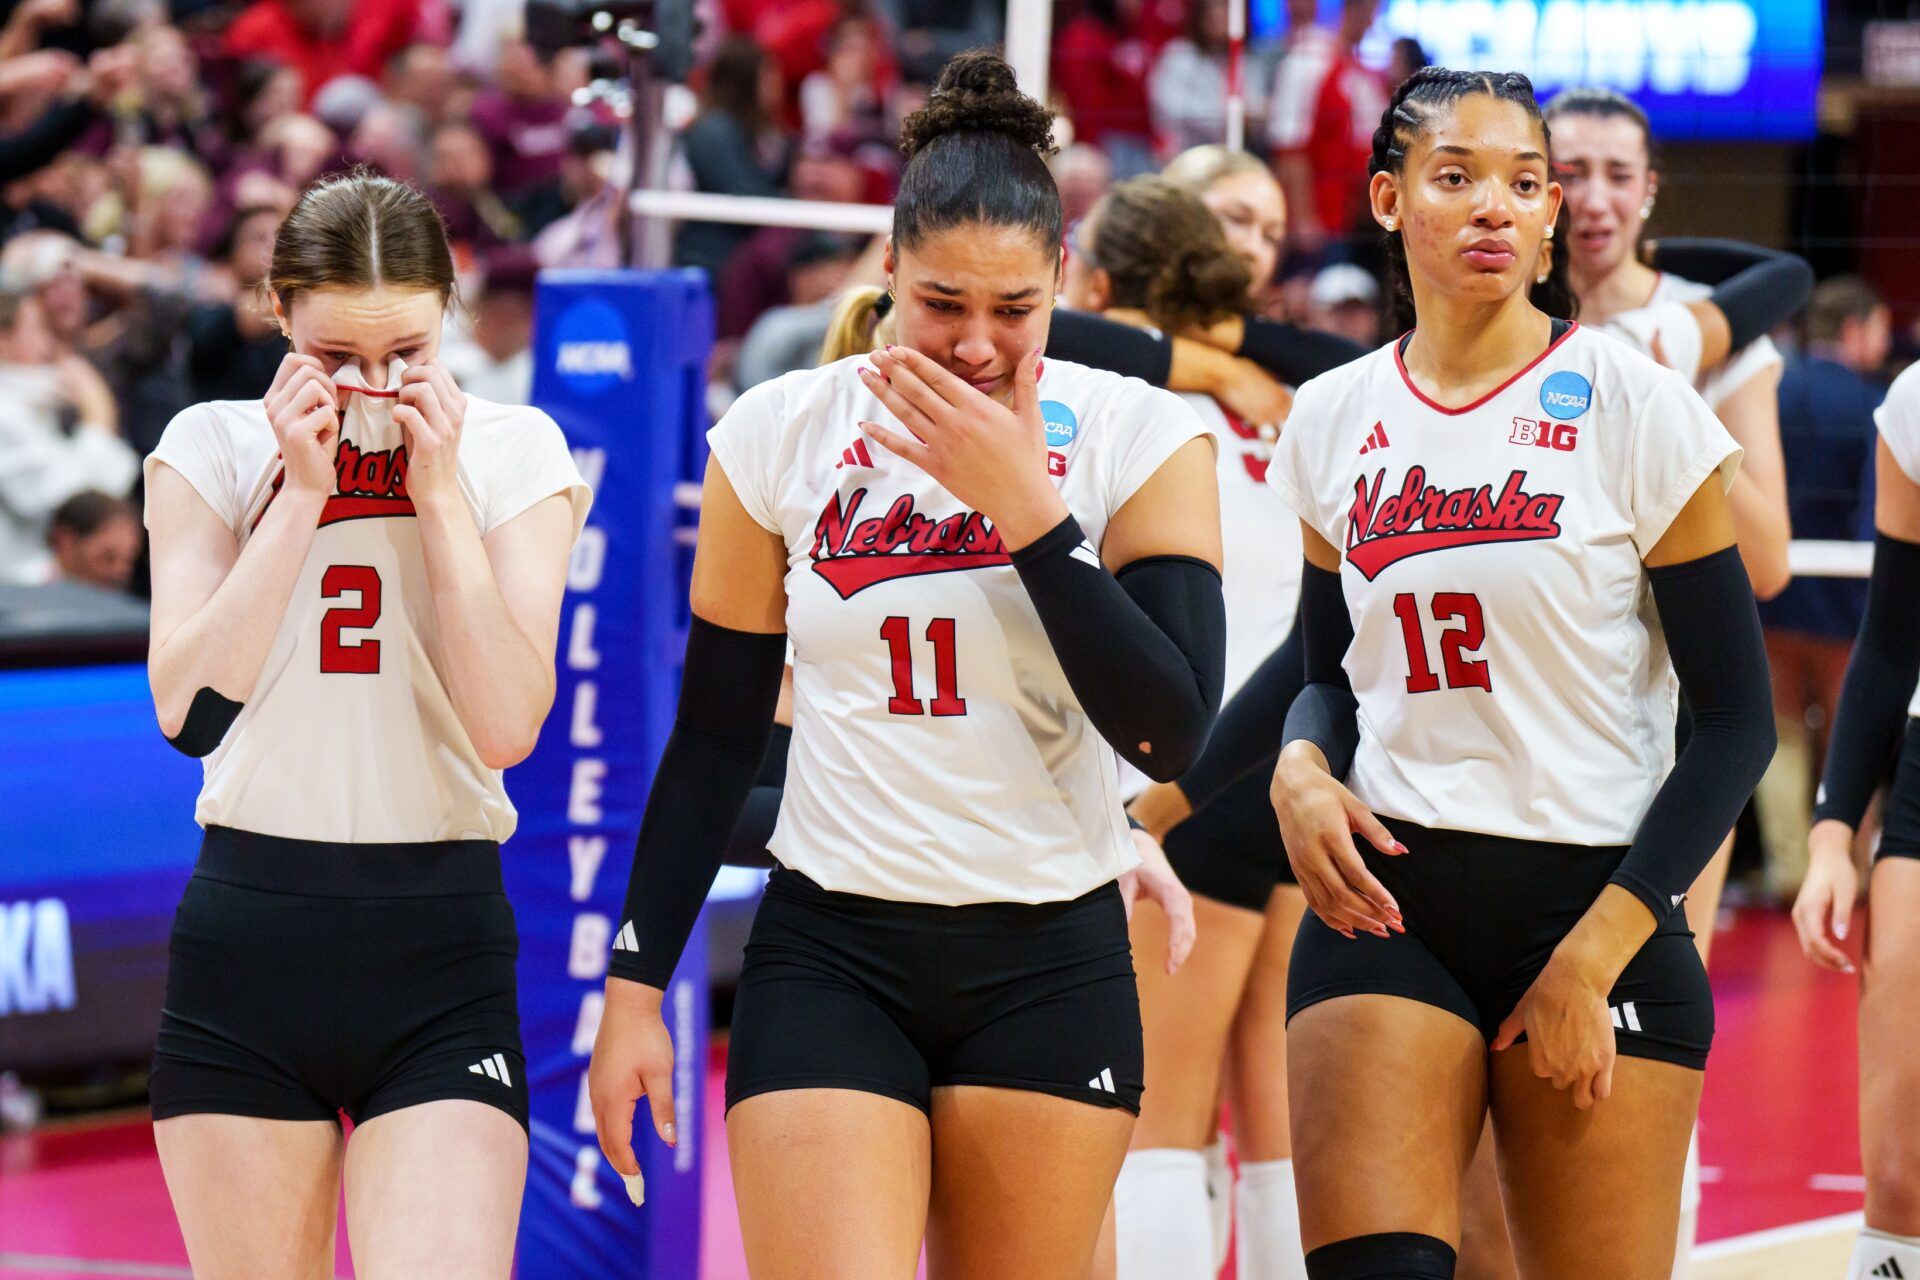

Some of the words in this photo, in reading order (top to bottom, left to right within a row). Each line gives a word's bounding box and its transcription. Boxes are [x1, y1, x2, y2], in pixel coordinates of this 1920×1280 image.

[1043, 420, 1073, 437] CAA
[1546, 391, 1588, 409] NCAA
[808, 487, 1009, 561] Nebras
[1346, 465, 1565, 550] Nebraska
[320, 564, 382, 674] 2
[1393, 592, 1493, 694] 12
[879, 615, 968, 717] 11
